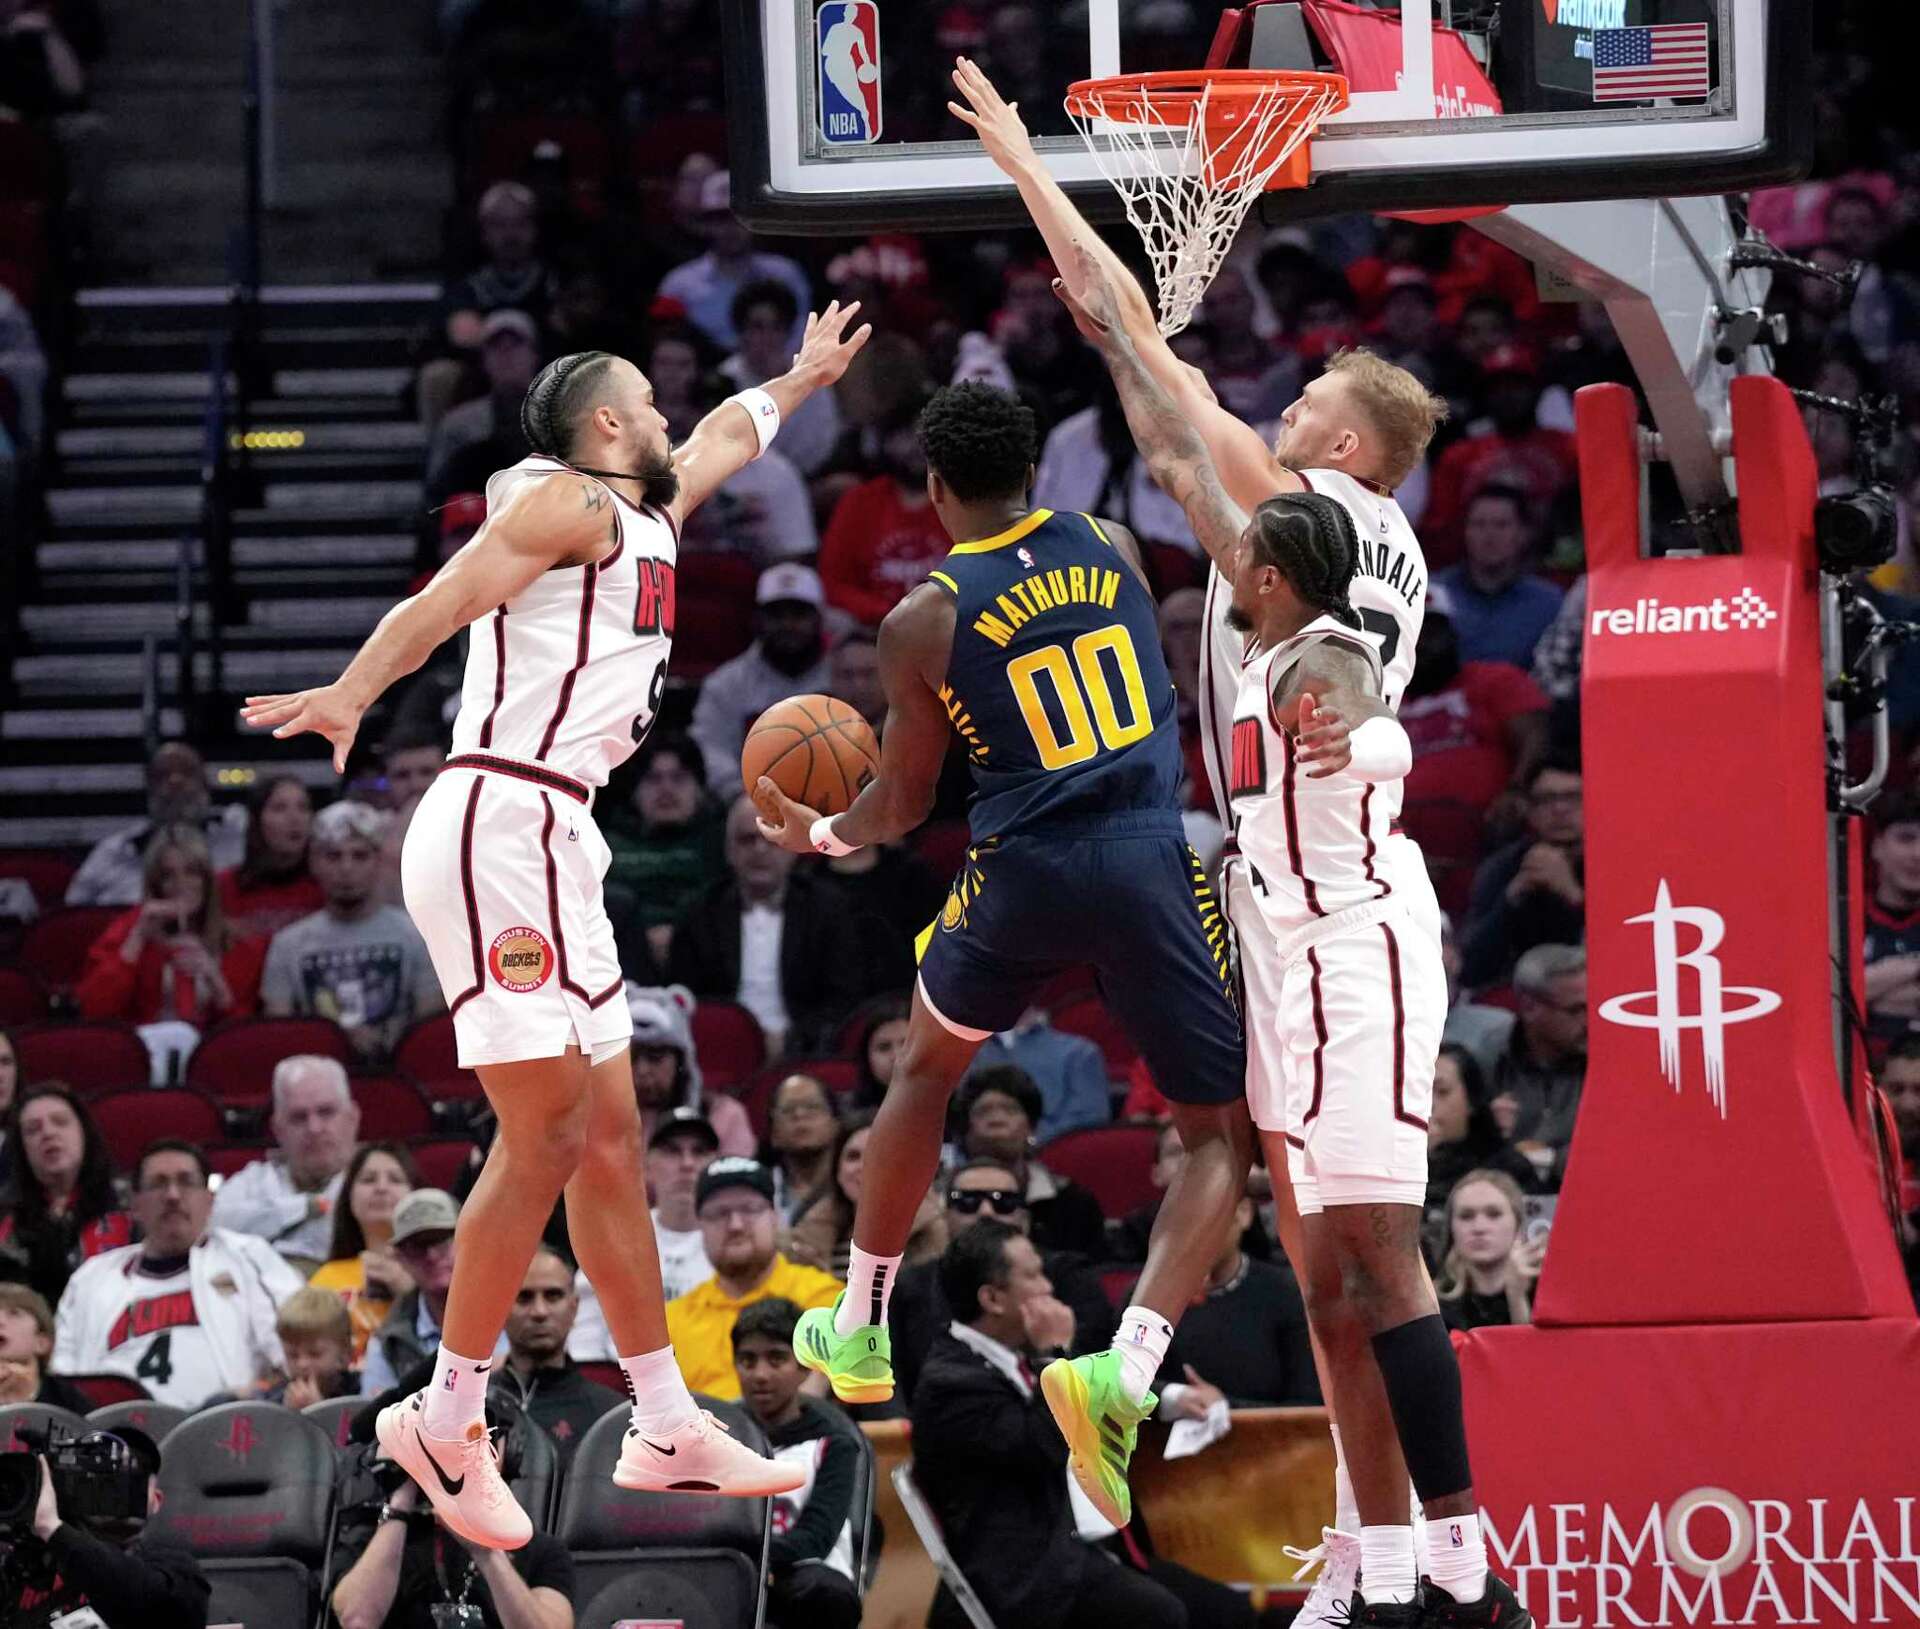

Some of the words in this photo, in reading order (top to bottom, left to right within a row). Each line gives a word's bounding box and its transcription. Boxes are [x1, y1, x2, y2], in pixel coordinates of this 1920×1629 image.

[829, 112, 859, 136] NBA
[973, 566, 1121, 648] MATHURIN
[1591, 597, 1730, 636] reliant
[1006, 623, 1155, 772] 00
[493, 928, 547, 948] HOUSTON
[501, 976, 543, 990] SUMMIT
[137, 1331, 172, 1384] 4
[867, 1336, 877, 1352] 0
[1478, 1497, 1920, 1569] MEMORIAL
